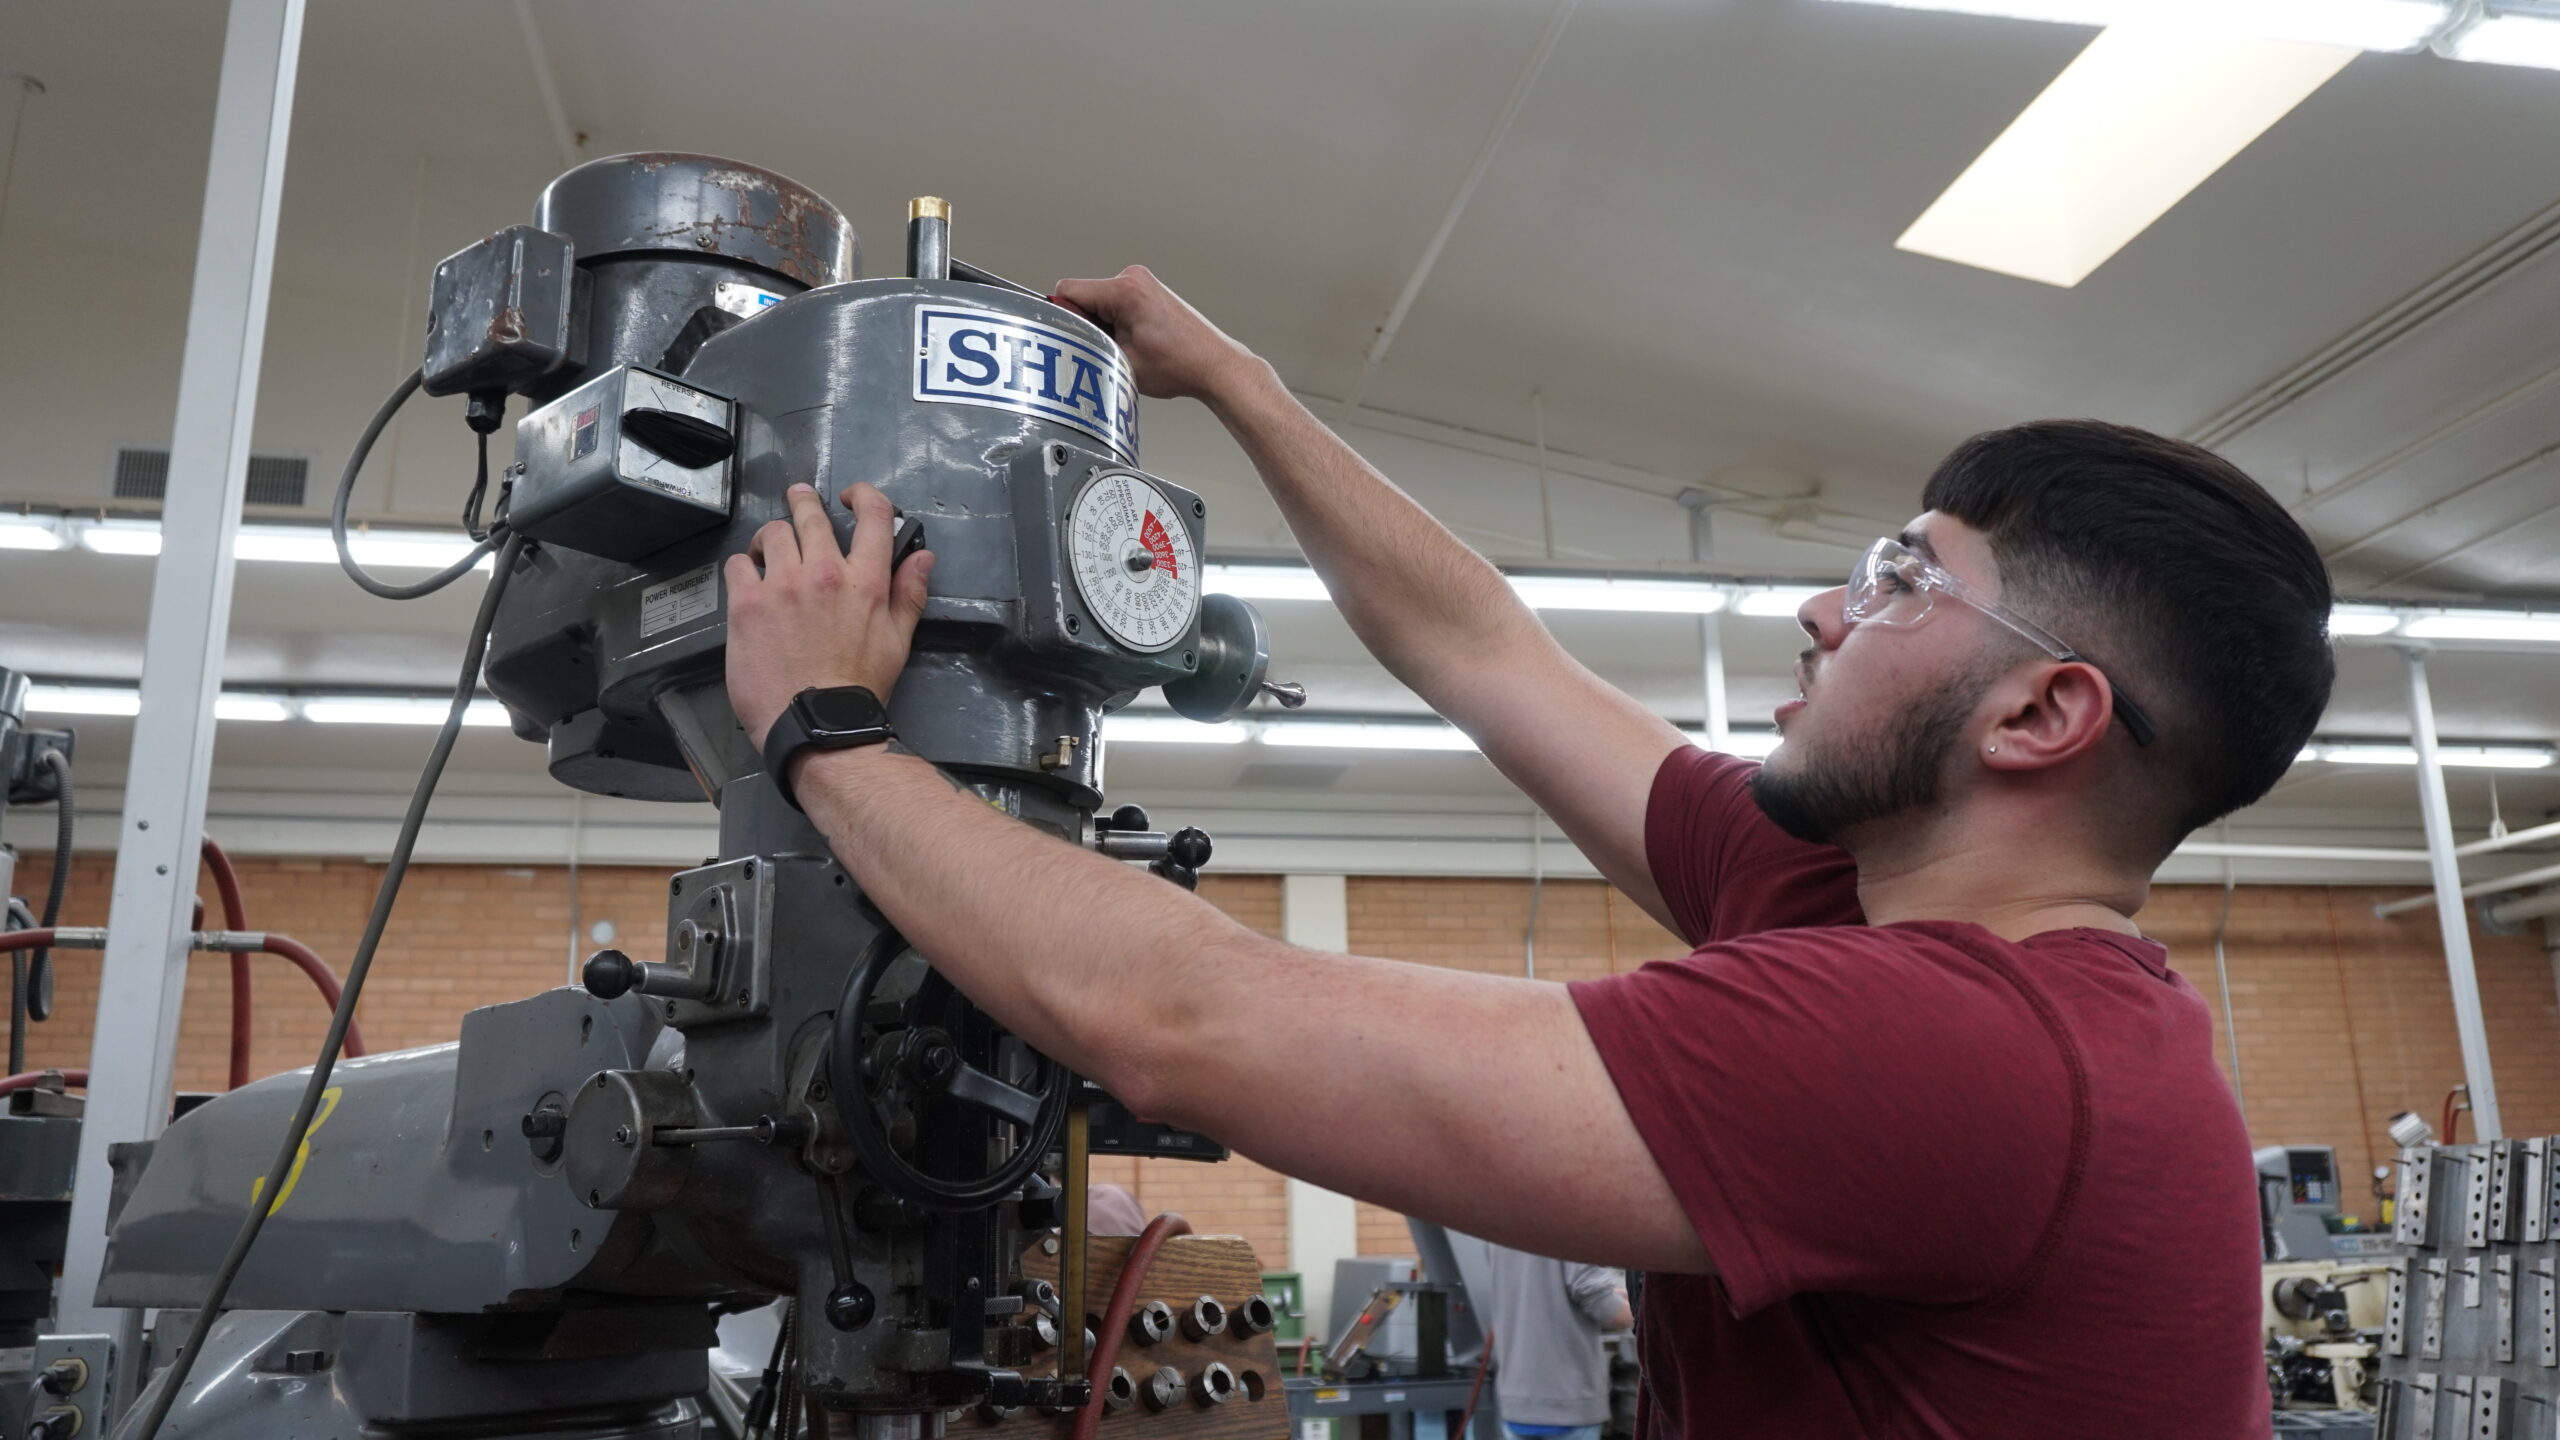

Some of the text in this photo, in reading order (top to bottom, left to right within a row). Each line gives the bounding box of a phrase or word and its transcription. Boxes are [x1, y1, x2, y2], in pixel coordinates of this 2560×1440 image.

[661, 380, 696, 399] REVERSE
[946, 328, 1139, 452] SHAR
[652, 478, 692, 497] FORWARD
[1114, 479, 1134, 532] APPROXIMATE
[1121, 479, 1140, 523] SPEEDS ARE
[1108, 516, 1119, 531] 600
[1081, 550, 1092, 560] 130
[1099, 552, 1113, 562] 1000
[645, 571, 713, 605] POWER REQUIREMENT
[1167, 608, 1179, 623] 300
